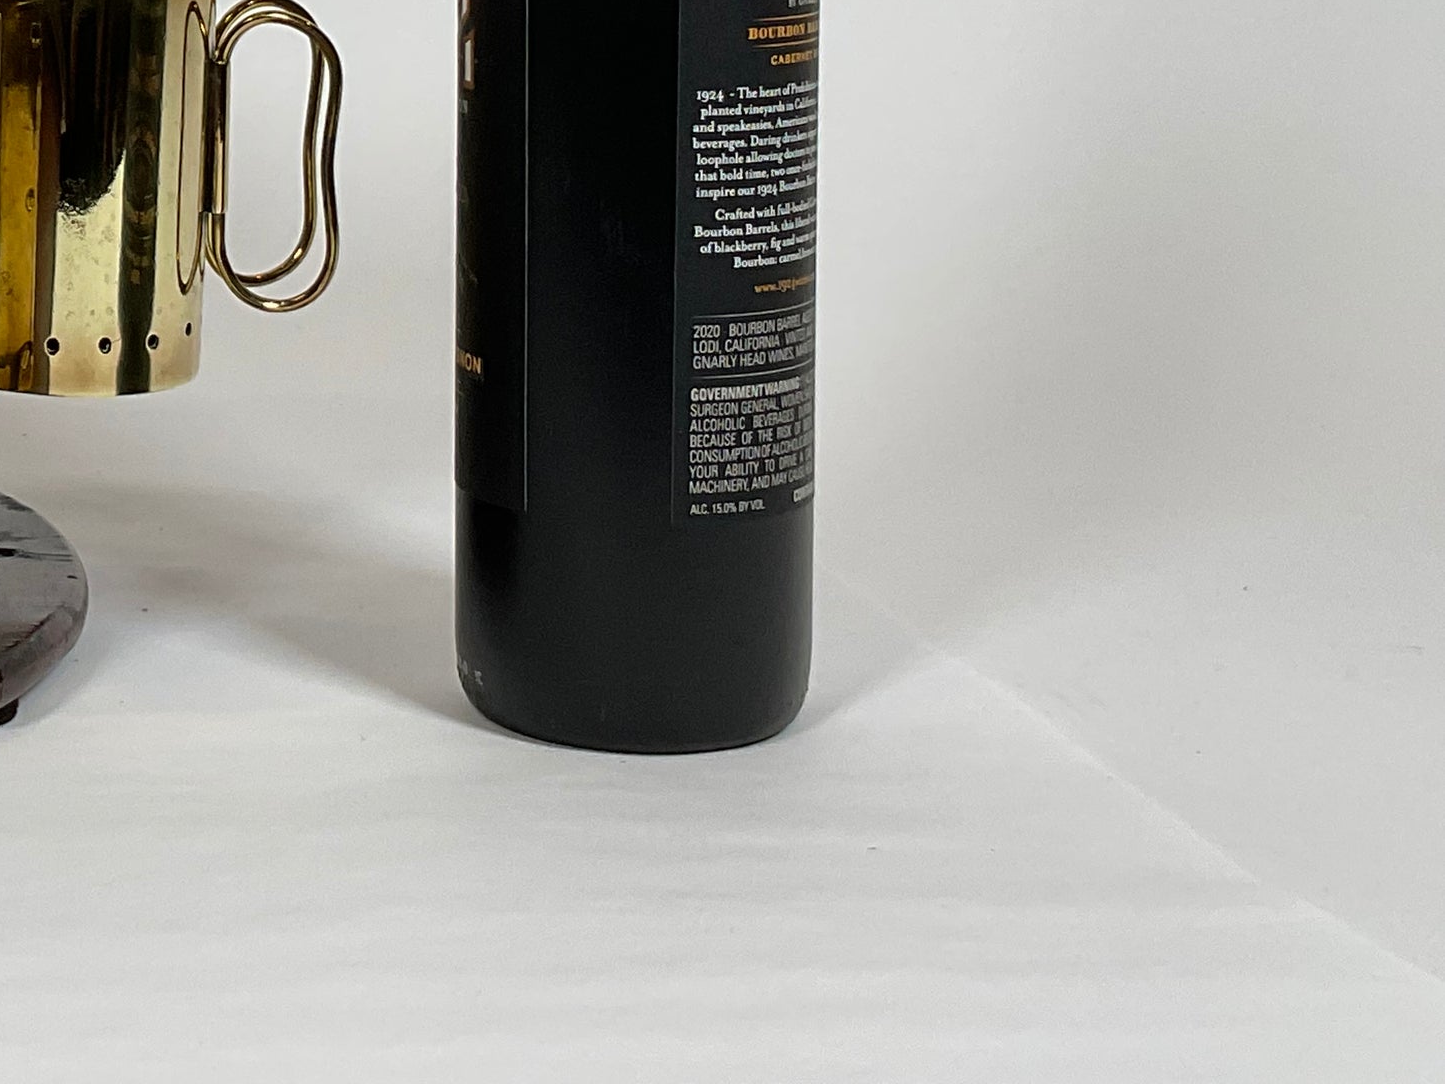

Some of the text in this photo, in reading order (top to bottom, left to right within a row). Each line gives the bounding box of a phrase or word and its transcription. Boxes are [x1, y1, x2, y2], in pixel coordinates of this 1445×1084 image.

[748, 23, 805, 40] BOURBON
[696, 90, 724, 103] 1924
[736, 87, 758, 99] The
[759, 85, 781, 99] heart
[782, 83, 792, 96] of
[700, 104, 742, 120] planted
[743, 100, 785, 117] vineyards
[692, 121, 715, 133] and
[692, 137, 748, 152] beverages.
[750, 134, 782, 148] Daring
[696, 153, 744, 169] loophole
[745, 150, 783, 164] allowing
[695, 168, 786, 182] that bold time, two
[696, 187, 735, 201] inspire
[737, 187, 755, 196] our
[757, 184, 777, 197] 1924
[715, 206, 755, 221] Crafted
[756, 204, 776, 218] with
[694, 225, 743, 237] Bourbon
[745, 221, 780, 236] Barrels,
[700, 241, 715, 254] of
[715, 240, 769, 254] blackberry,
[770, 236, 782, 252] fig
[782, 234, 795, 247] and
[733, 255, 778, 269] Bourbon:
[693, 324, 720, 338] 2020
[729, 319, 776, 337] BOURBON
[693, 340, 722, 354] LODI,
[725, 334, 780, 352] CALIFORNIA
[693, 356, 737, 369] GNARLY
[740, 352, 766, 366] HEAD
[768, 346, 794, 363] WINES
[690, 383, 764, 401] GOVERNMENT
[690, 402, 738, 417] SURGEON
[689, 416, 745, 432] ALCOHOLIC
[690, 431, 736, 448] BECAUSE
[741, 431, 753, 445] OF
[758, 429, 773, 442] THE
[689, 445, 761, 464] CONSUMPTION
[761, 443, 771, 457] OF
[689, 464, 719, 479] YOUR
[724, 461, 759, 477] ABILITY
[764, 459, 775, 472] TO
[751, 475, 770, 490] AND
[771, 471, 788, 487] MAY
[690, 503, 710, 515] ALC.
[712, 501, 737, 514] 15.0%
